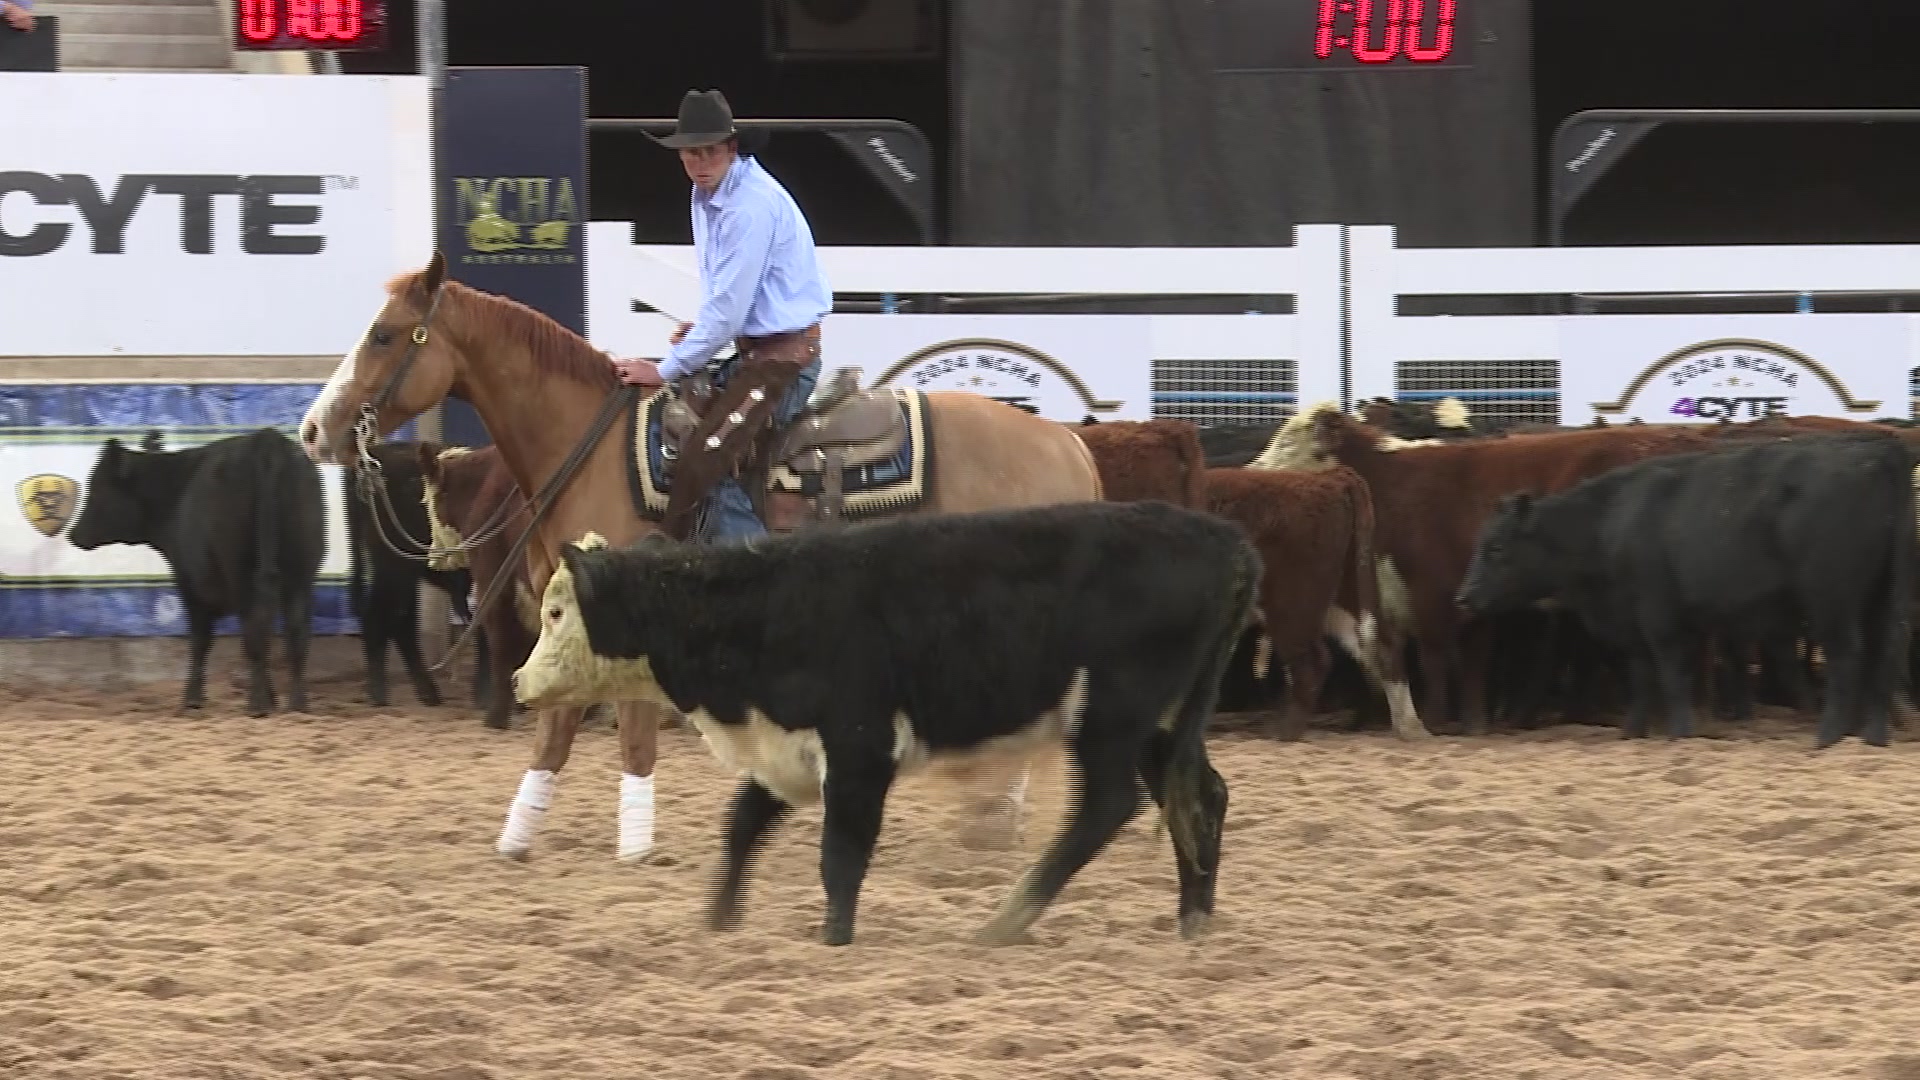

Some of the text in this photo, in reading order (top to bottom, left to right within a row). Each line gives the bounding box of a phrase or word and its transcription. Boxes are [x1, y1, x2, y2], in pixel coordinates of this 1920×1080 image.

[1315, 0, 1456, 62] 1:00
[452, 176, 580, 224] NCHA
[459, 255, 577, 264] AUSTRALIA
[912, 355, 1042, 388] 2024 NCHA
[1667, 355, 1799, 389] 2024 NCHA
[1668, 397, 1789, 418] 4CYTE
